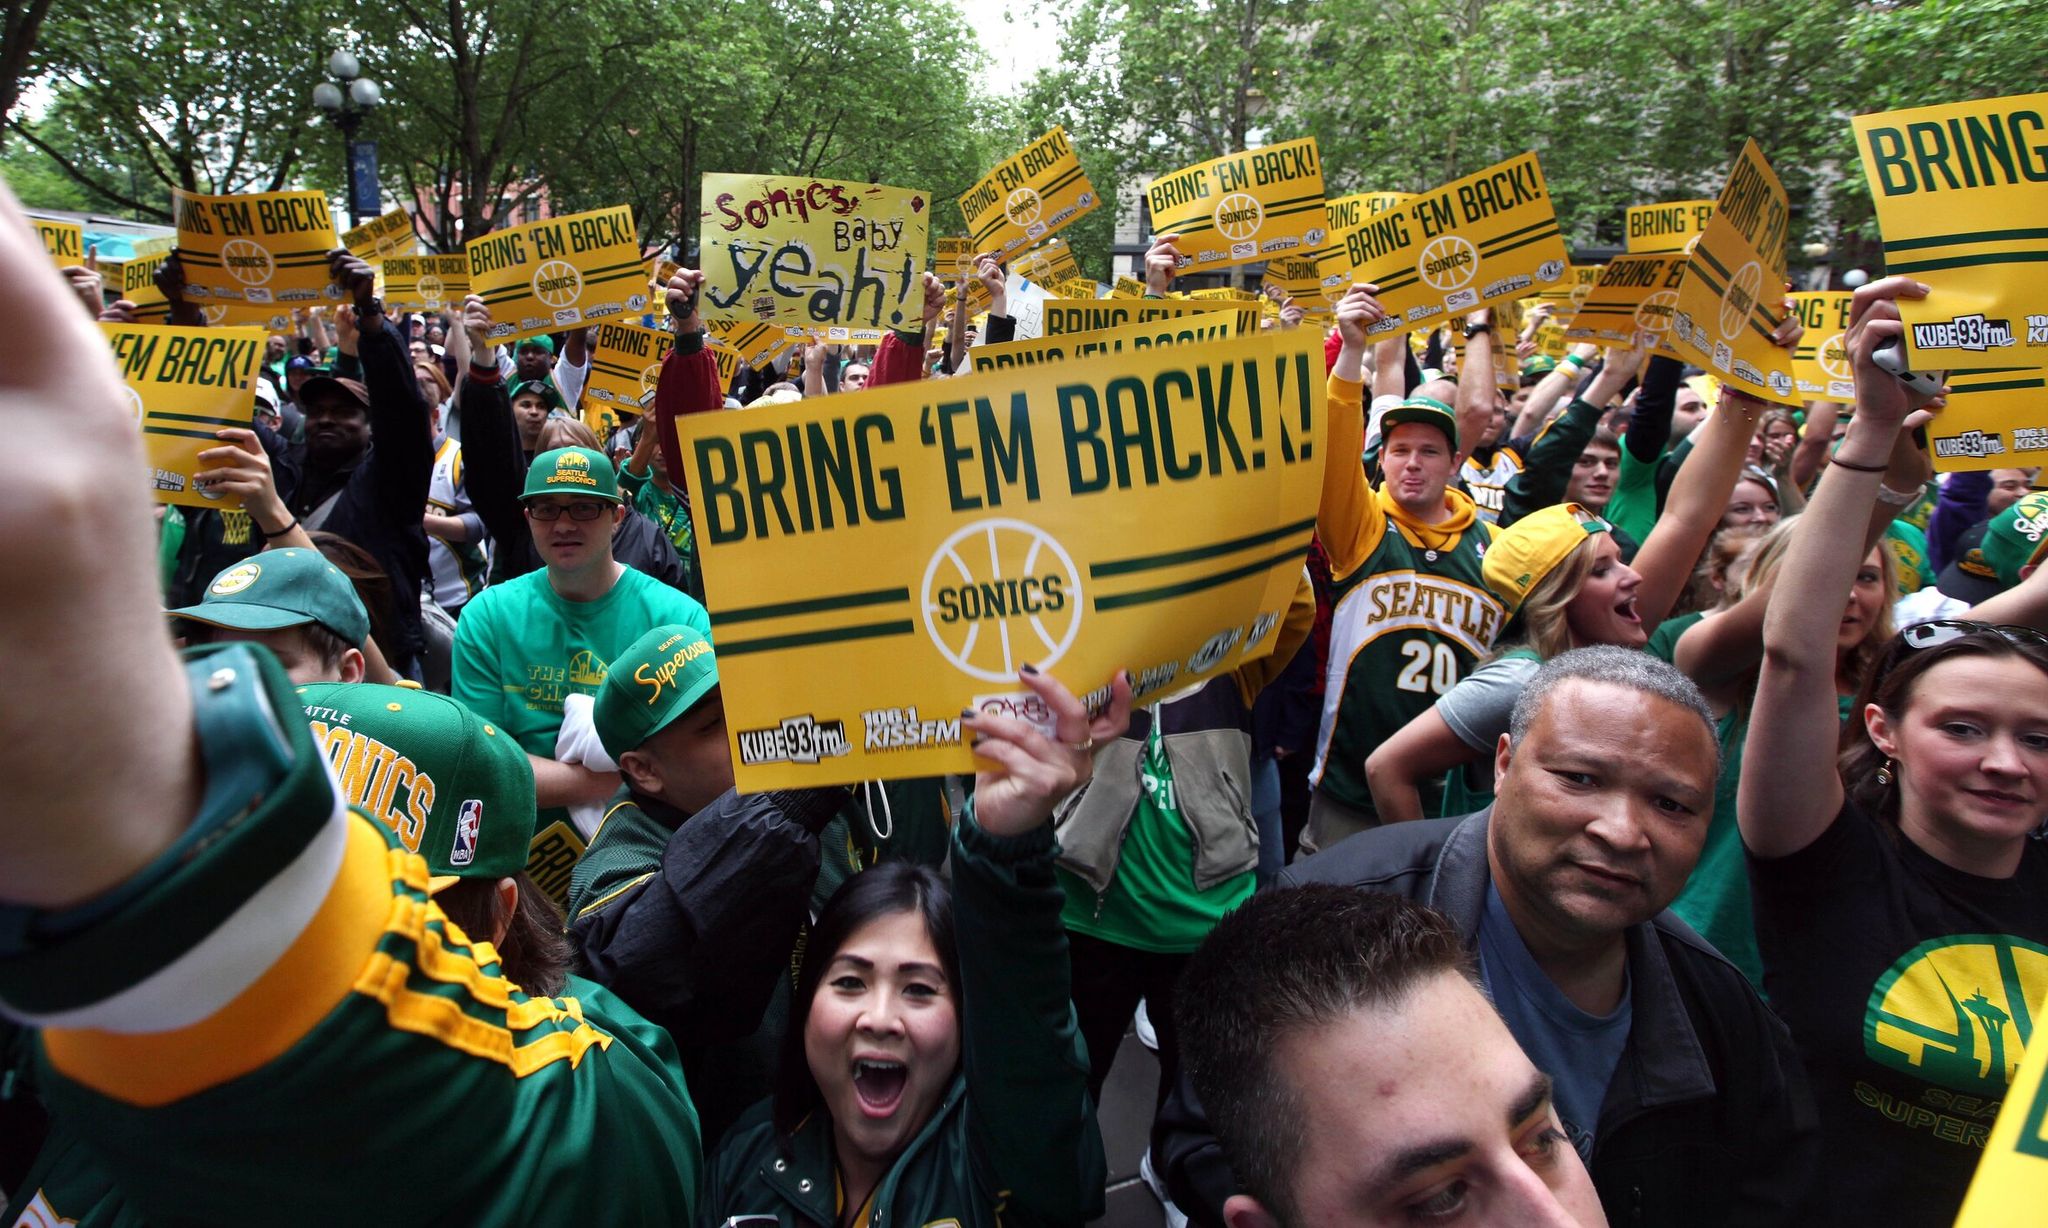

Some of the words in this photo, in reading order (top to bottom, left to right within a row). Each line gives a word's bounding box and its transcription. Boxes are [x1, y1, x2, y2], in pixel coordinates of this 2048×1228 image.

[1866, 110, 2048, 196] BRING
[961, 180, 998, 224] BRING
[995, 162, 1024, 193] 'EM
[1021, 131, 1068, 178] BACK!
[1150, 169, 1210, 214] BRING
[1213, 159, 1249, 193] 'EM
[1252, 144, 1316, 186] BACK!
[211, 201, 254, 236] 'EM
[257, 197, 330, 235] BACK!
[1009, 195, 1037, 217] SONICS
[1220, 208, 1257, 225] SONICS
[1326, 199, 1359, 231] RING
[1346, 212, 1411, 268] BRING
[1412, 194, 1457, 239] 'EM
[1457, 161, 1541, 224] BACK!
[834, 218, 903, 251] Baby
[1631, 206, 1685, 239] BRING
[40, 226, 78, 258] CK!
[469, 233, 527, 277] BRING
[529, 224, 566, 261] 'EM
[568, 211, 633, 254] BACK!
[226, 256, 268, 268] SONICS
[383, 258, 417, 276] BRING
[1286, 260, 1319, 281] BRING
[1426, 250, 1472, 276] SONICS
[1598, 259, 1665, 287] BRING
[539, 275, 576, 293] SONICS
[704, 246, 913, 327] yeah!
[1833, 298, 1852, 329] 'E
[600, 323, 650, 358] BRING
[155, 336, 258, 390] BACK!
[693, 412, 906, 546] BRING
[920, 390, 1042, 514] 'EM
[1055, 358, 1266, 496] BACK!
[2013, 437, 2048, 450] KISS
[157, 468, 185, 486] RADIO
[546, 475, 597, 487] SUPERSONICS
[556, 469, 588, 478] SEATTLE
[937, 574, 1065, 626] SONICS
[1367, 580, 1497, 649] SEATTLE
[527, 664, 565, 682] THE
[1396, 639, 1458, 696] 20
[302, 704, 353, 726] ATTLE
[1854, 1080, 1995, 1149] SUPER
